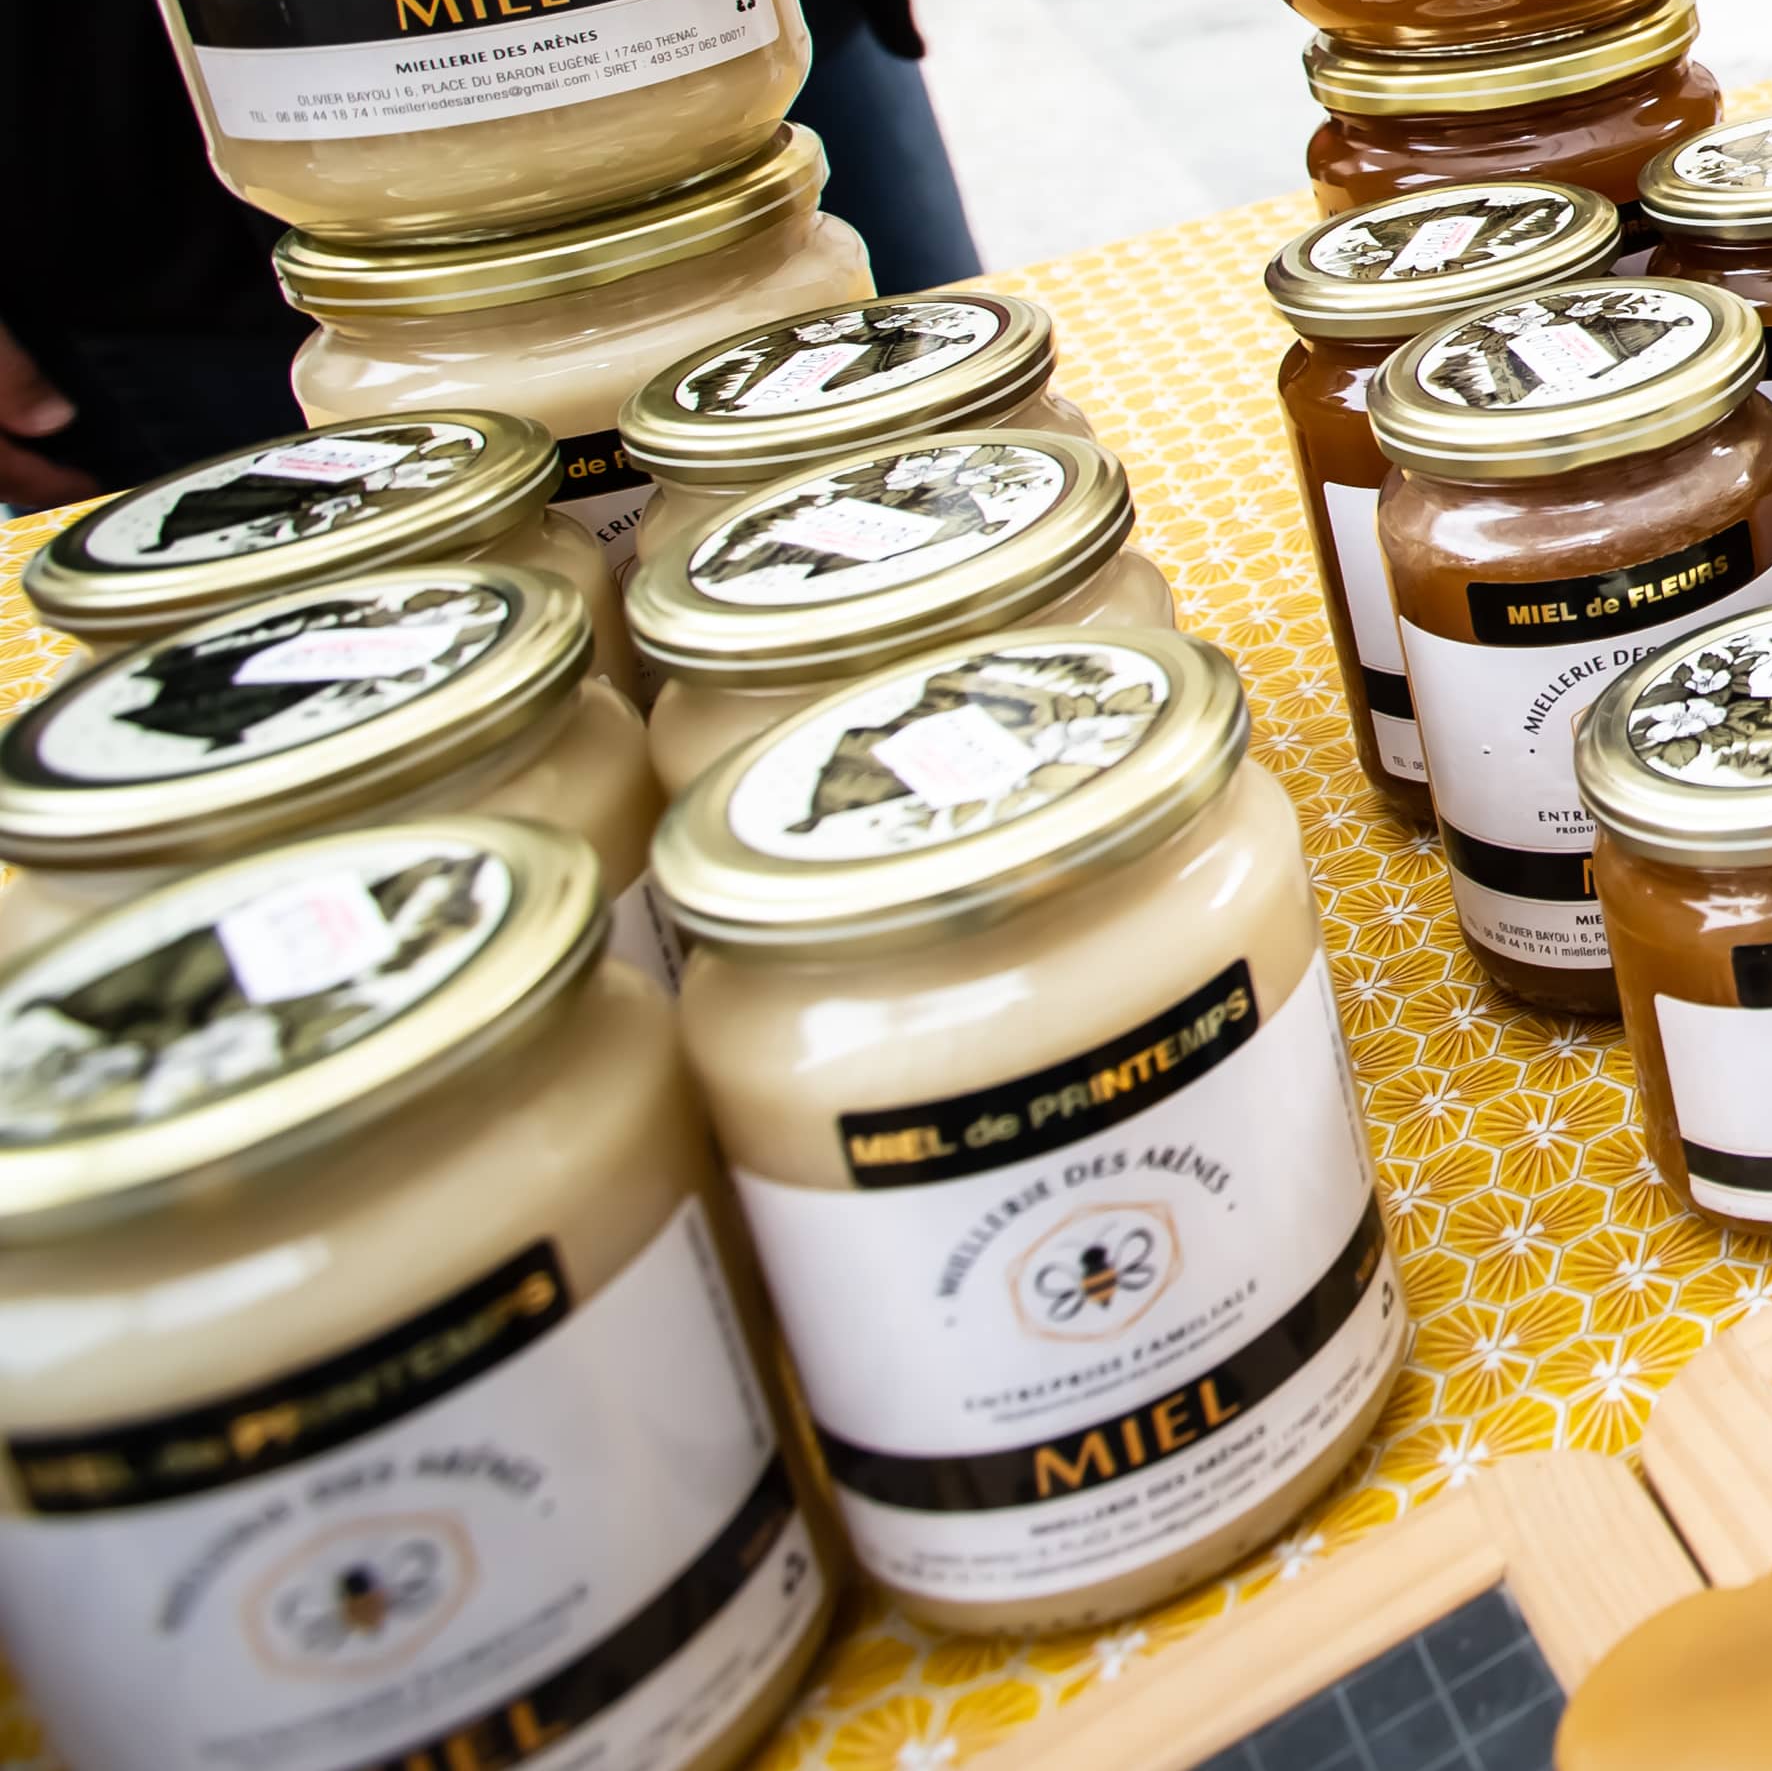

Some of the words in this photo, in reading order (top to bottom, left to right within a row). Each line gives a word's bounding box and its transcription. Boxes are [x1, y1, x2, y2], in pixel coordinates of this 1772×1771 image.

[311, 106, 328, 122] 44
[351, 105, 369, 120] 74
[602, 58, 640, 79] SIRET
[650, 47, 674, 66] 493
[675, 42, 697, 63] 537
[698, 35, 720, 55] 062
[346, 83, 391, 105] BAYOU
[421, 75, 468, 95] PLACE
[471, 70, 493, 87] DU
[496, 61, 545, 84] BARON
[548, 49, 602, 75] EUGÈNE
[613, 39, 653, 60] 17460
[655, 26, 700, 49] THENAC
[395, 49, 490, 76] MIELLERIE
[492, 42, 530, 62] DES
[532, 29, 599, 54] ARÈNES
[568, 457, 606, 479] de
[1507, 602, 1577, 625] MIEL
[1586, 597, 1620, 618] de
[1627, 555, 1728, 608] FLEURS
[1523, 655, 1607, 735] MIELLERIE
[849, 1123, 959, 1168] MIEL
[964, 1111, 1021, 1147] de
[1028, 986, 1251, 1131] PRINTEMPS
[1033, 1378, 1241, 1499] MIEL
